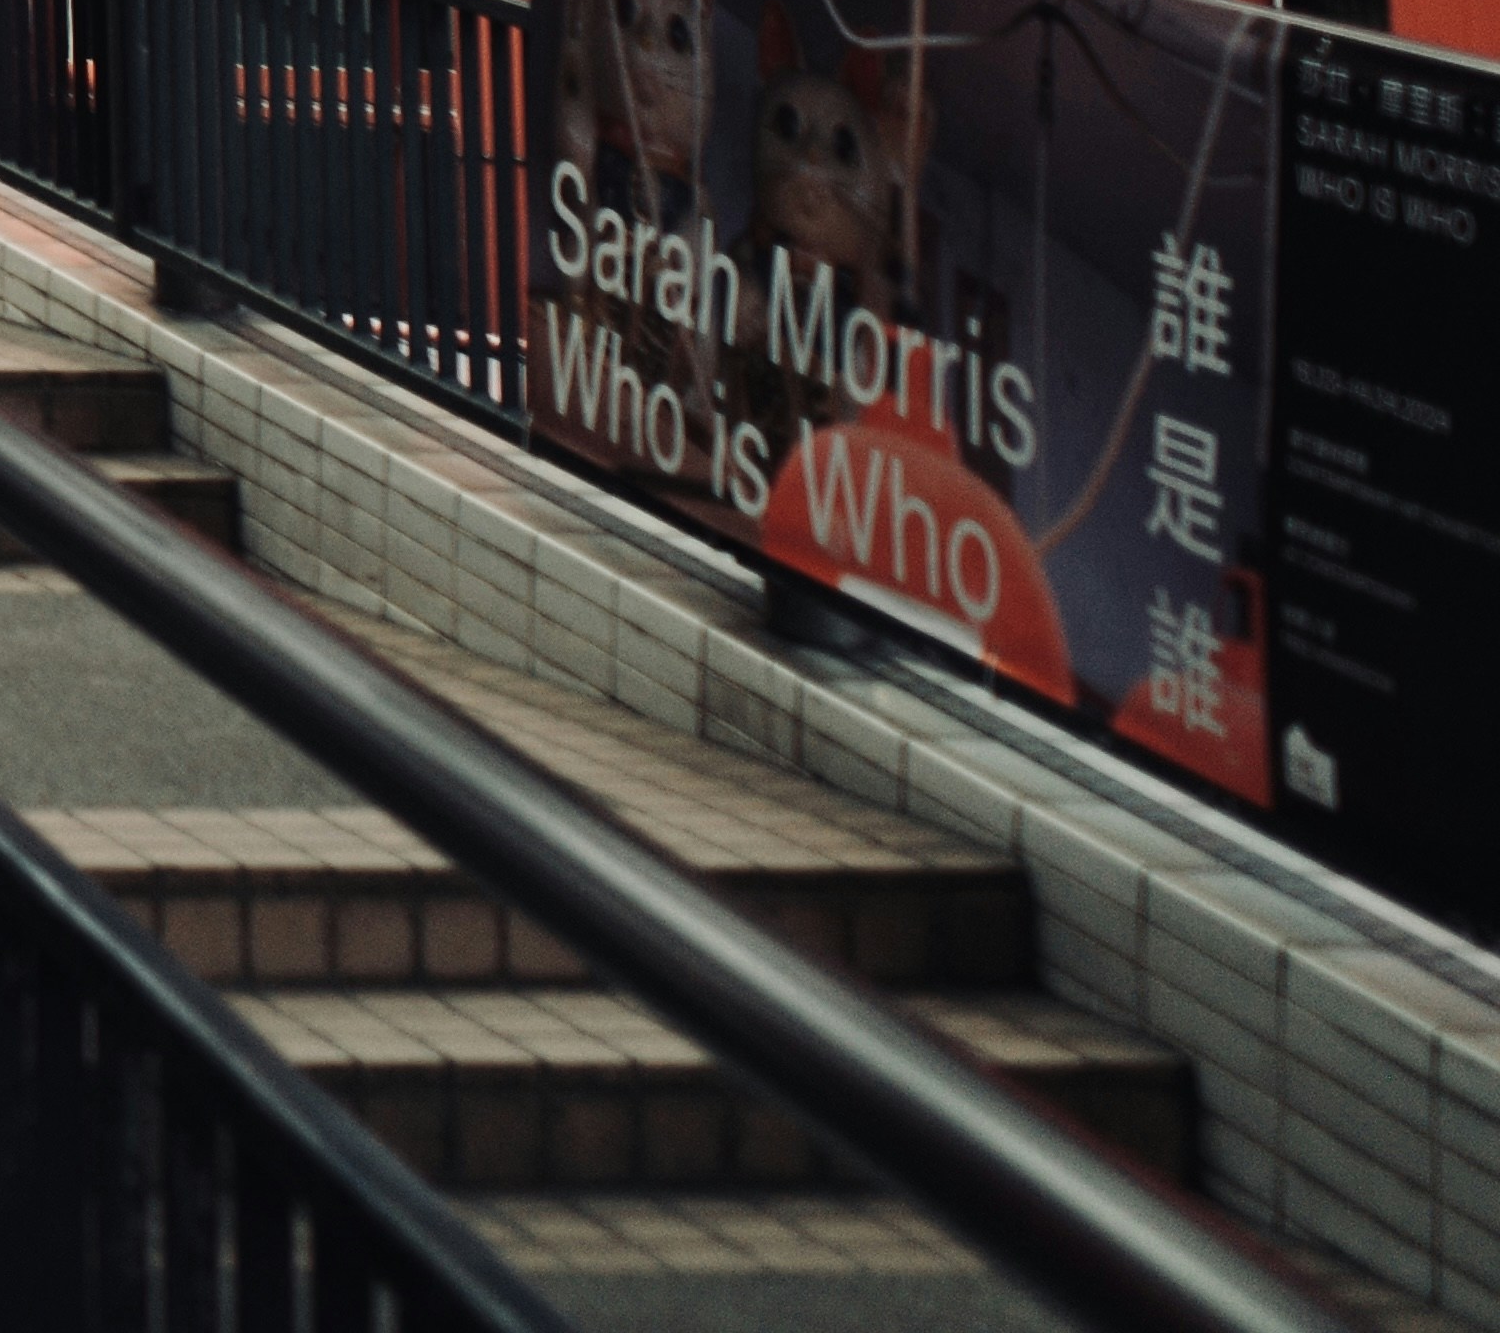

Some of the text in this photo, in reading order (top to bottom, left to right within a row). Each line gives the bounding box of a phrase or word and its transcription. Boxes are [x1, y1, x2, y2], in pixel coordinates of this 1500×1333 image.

[546, 300, 1001, 625] Who is Who
[548, 160, 1040, 469] Sarah Morris
[1146, 235, 1235, 741] 誰是誰
